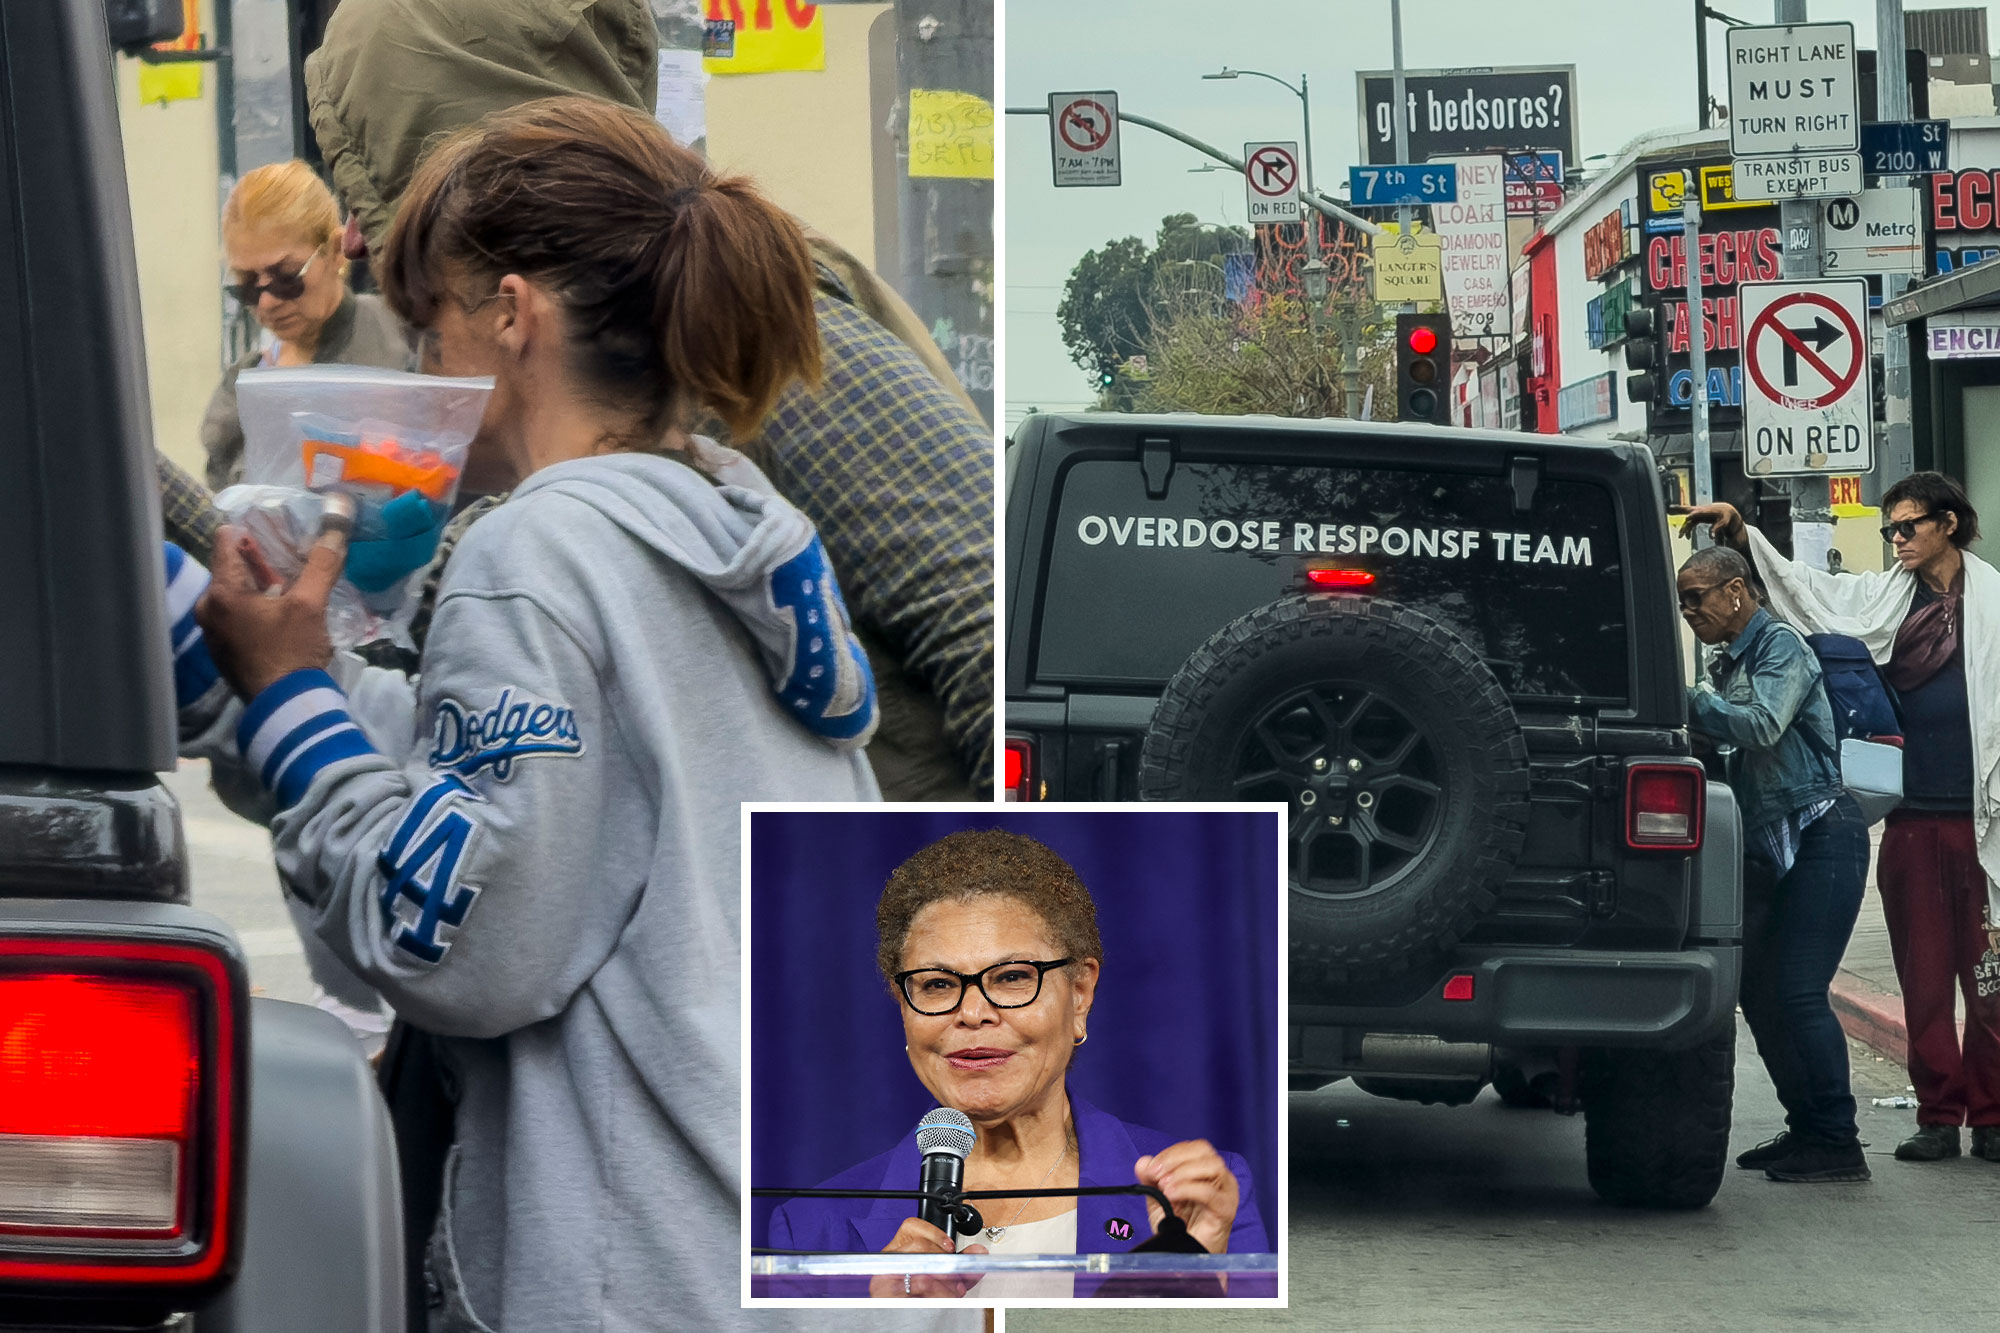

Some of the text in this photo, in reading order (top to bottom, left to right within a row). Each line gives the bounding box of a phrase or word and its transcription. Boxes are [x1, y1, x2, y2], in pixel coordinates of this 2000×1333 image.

[1736, 44, 1846, 65] RIGHT LANE
[1749, 78, 1836, 101] MUST
[1376, 84, 1563, 142] gt bedsores?
[1739, 114, 1849, 135] TURN RIGHT
[1923, 124, 1942, 142] St
[1744, 159, 1851, 177] TRANSIT BUS
[1875, 151, 1942, 170] 2100 W
[1457, 165, 1498, 186] NEY
[1707, 176, 1732, 188] WES
[1359, 170, 1406, 200] 7th
[1422, 173, 1447, 194] St
[1767, 177, 1828, 193] EXEMPT
[1252, 202, 1297, 216] ON RED
[1866, 223, 1916, 237] Metro
[1441, 233, 1502, 251] DIAMOND
[1379, 262, 1437, 273] LANGER'S
[1444, 254, 1502, 272] JEWELRY
[1649, 228, 1780, 290] CHECKS
[1827, 251, 1839, 268] 2
[1384, 275, 1432, 286] SQUARE
[1464, 277, 1493, 291] CASA
[1451, 296, 1464, 309] DE
[1757, 425, 1860, 456] ON RED
[1078, 515, 1281, 550] OVERDOSE
[1492, 532, 1592, 566] TEAM
[1110, 1220, 1129, 1238] M
